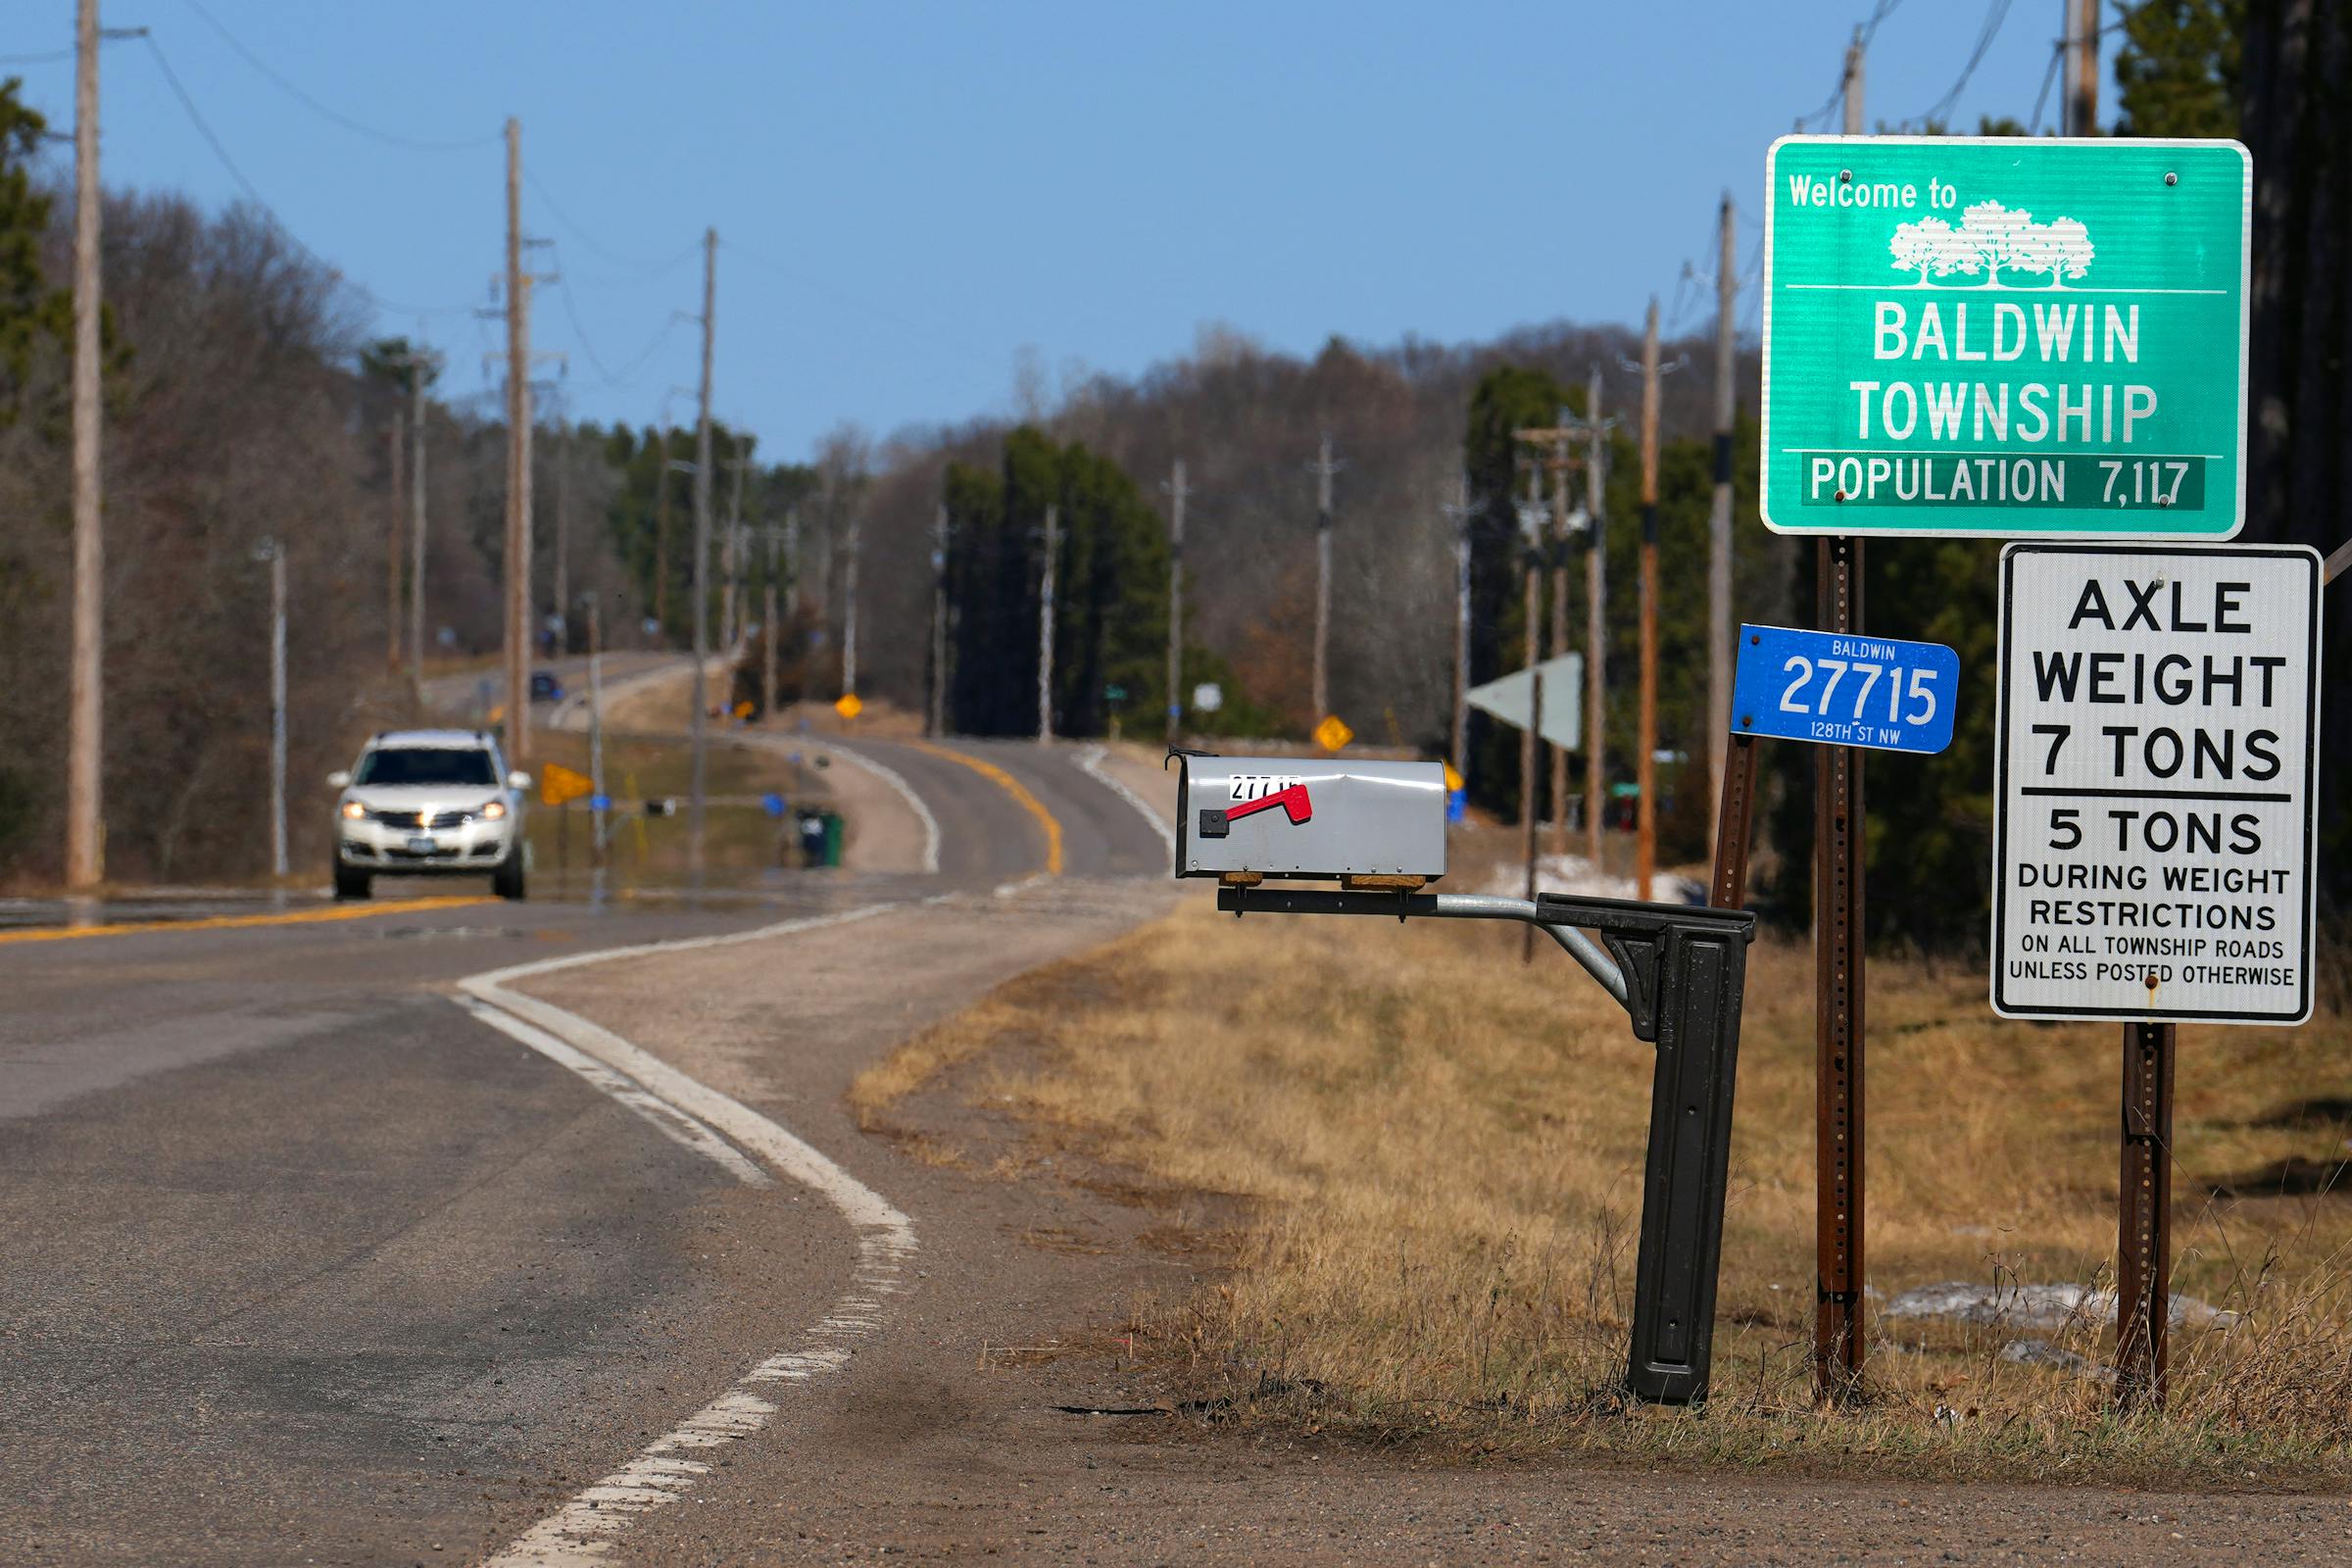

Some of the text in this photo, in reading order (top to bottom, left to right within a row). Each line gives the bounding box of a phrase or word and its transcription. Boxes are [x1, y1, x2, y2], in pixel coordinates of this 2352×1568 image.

[1788, 174, 1957, 209] Welcome to
[1873, 301, 2139, 364] BALDWIN
[1850, 380, 2158, 444] TOWNSHIP
[1810, 457, 2189, 509] POPULATION 7,117
[2068, 579, 2251, 633] AXLE
[1832, 640, 1895, 661] BALDWIN
[1779, 656, 1937, 726] 27715
[2033, 651, 2286, 707] WEIGHT
[1810, 721, 1900, 745] 128TH ST NW
[2032, 724, 2280, 781] 7 TONS
[2048, 808, 2262, 855] 5 TONS
[2018, 862, 2290, 894] DURING WEIGHT
[2031, 900, 2276, 931] RESTRICTIONS
[2022, 934, 2283, 958] ON ALL TOWNSHIP ROADS
[2010, 960, 2294, 986] UNLESS POSTED OTHERWISE
